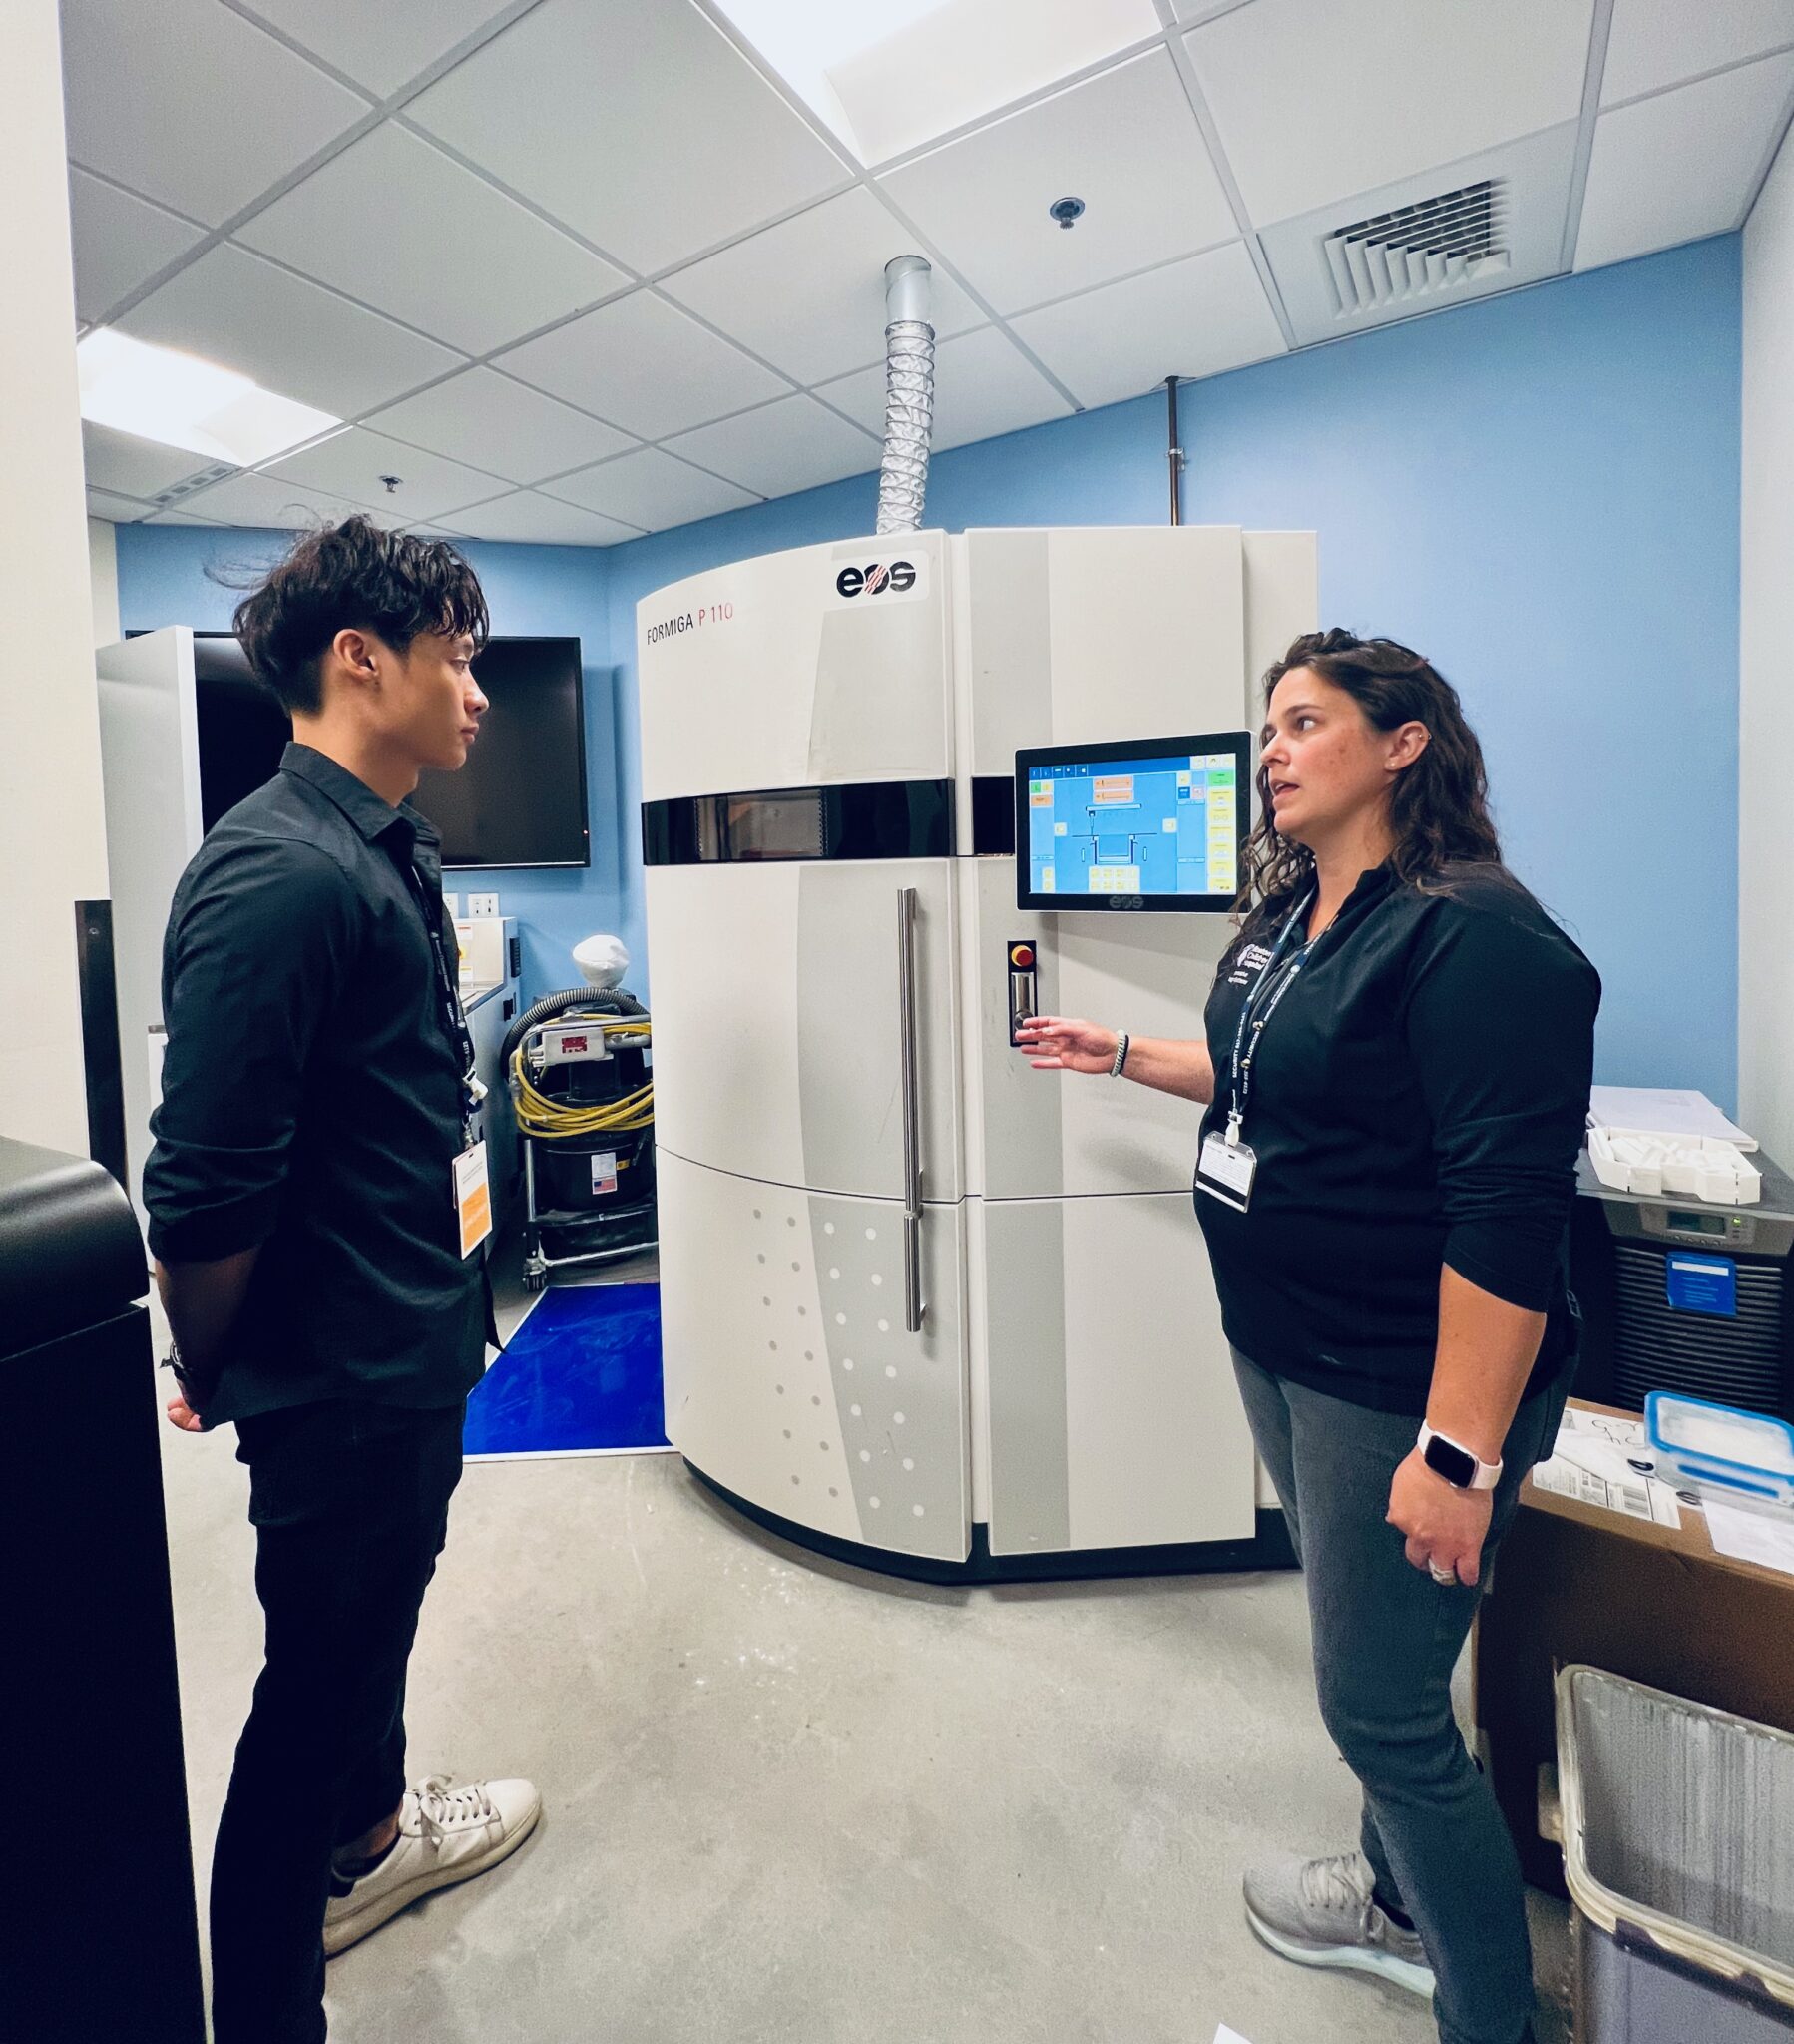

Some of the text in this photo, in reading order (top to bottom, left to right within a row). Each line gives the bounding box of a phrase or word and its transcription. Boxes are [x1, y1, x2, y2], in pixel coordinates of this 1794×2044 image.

[836, 561, 917, 598] eos
[647, 602, 734, 645] FORMIGA P 110
